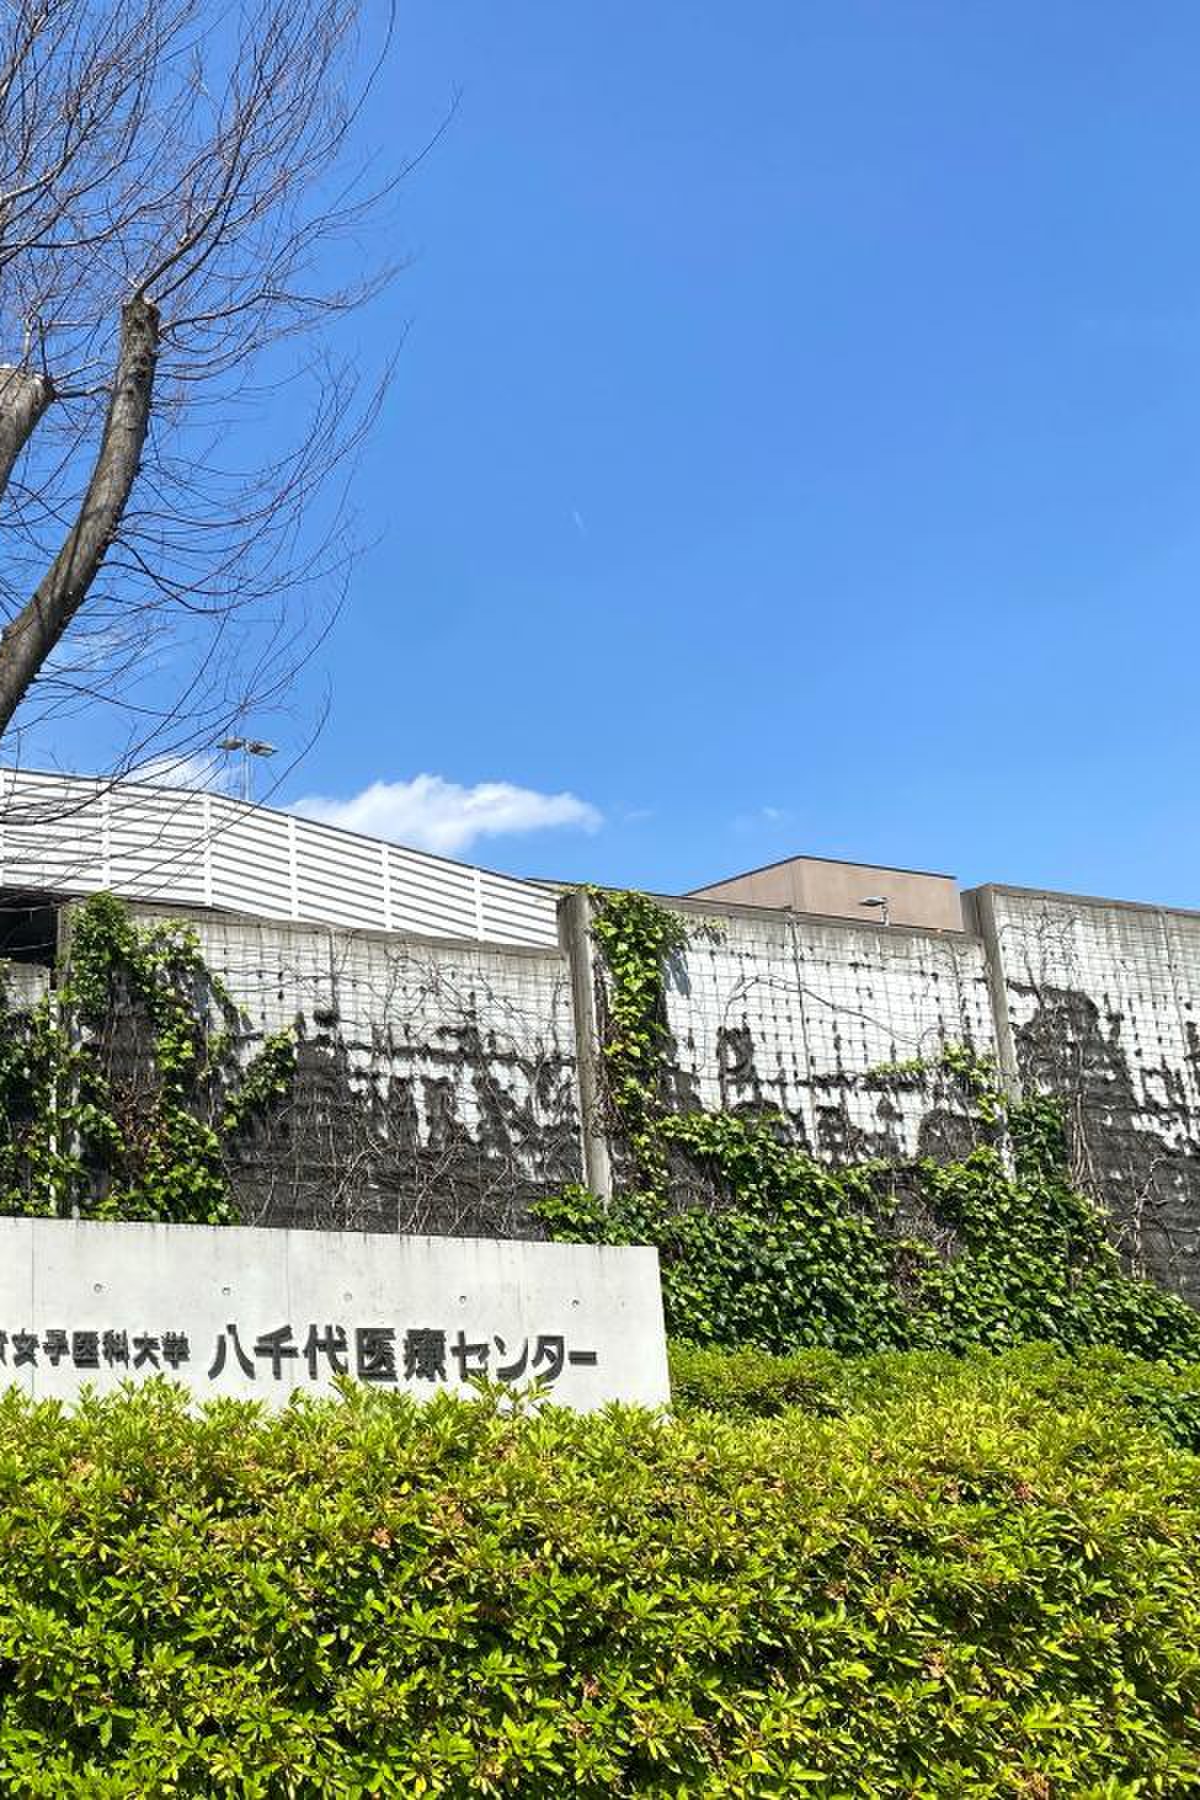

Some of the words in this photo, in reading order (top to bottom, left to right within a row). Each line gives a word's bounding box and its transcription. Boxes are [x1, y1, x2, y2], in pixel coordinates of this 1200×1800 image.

[208, 1324, 598, 1382] 八千代医療センター
